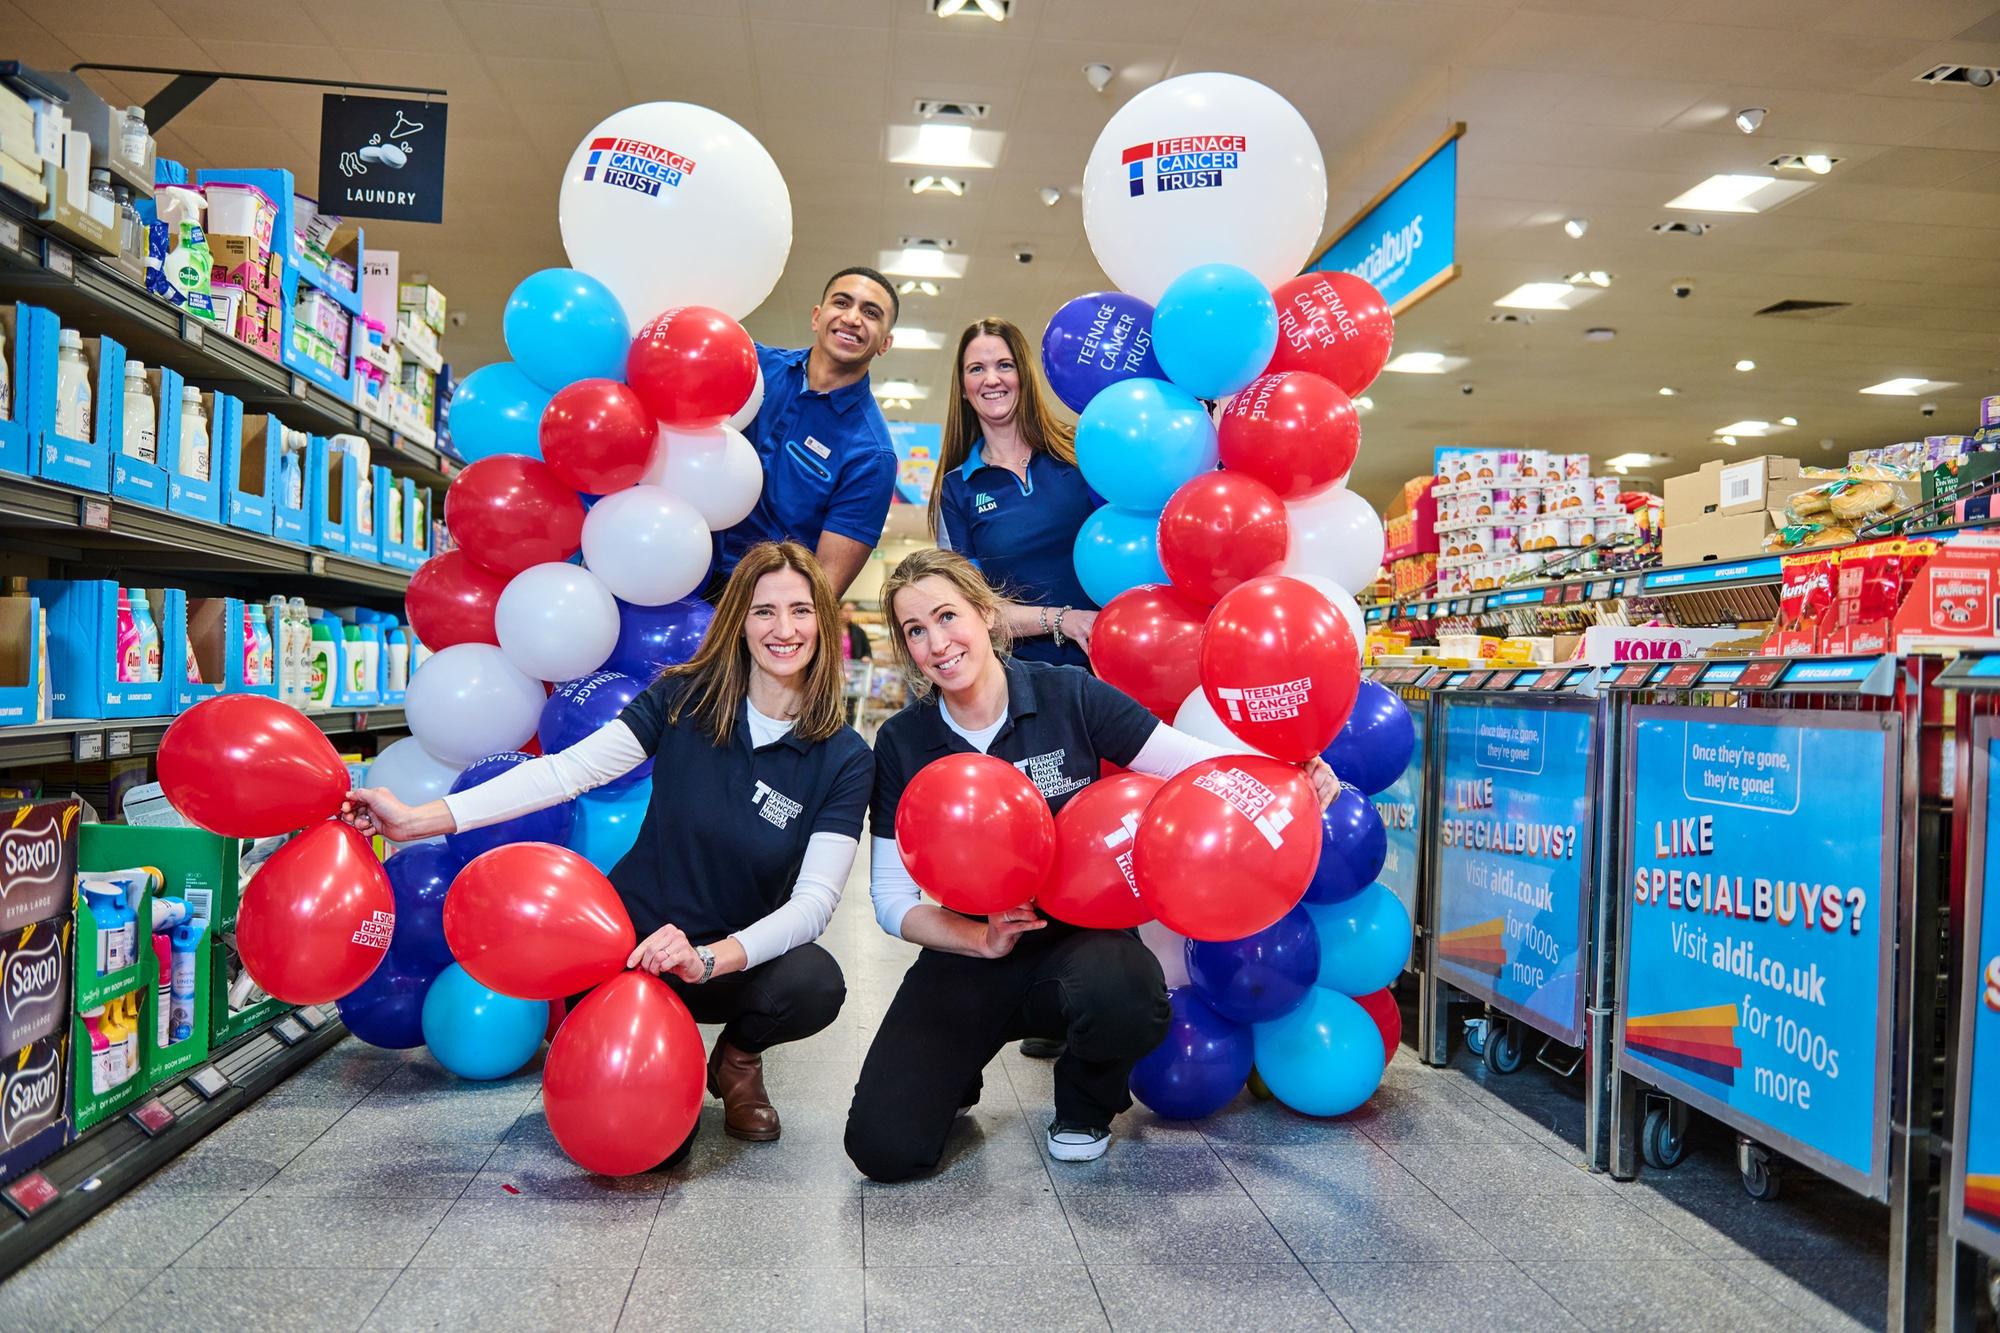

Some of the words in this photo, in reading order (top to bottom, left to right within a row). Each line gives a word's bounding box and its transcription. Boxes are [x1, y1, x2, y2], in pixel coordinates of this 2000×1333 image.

[619, 138, 694, 174] TEENAGE
[1159, 136, 1244, 155] TEENAGE
[611, 153, 680, 186] CANCER
[1158, 152, 1236, 172] CANCER
[608, 169, 659, 194] TRUST
[1159, 171, 1219, 191] TRUST
[347, 188, 416, 206] LAUNDRY
[179, 271, 200, 282] Dettol
[1294, 292, 1336, 349] CANCER
[1313, 280, 1360, 341] TEENAGE
[1077, 303, 1116, 365] TEENAGE
[1100, 313, 1136, 371] CANCER
[1279, 309, 1312, 353] TRUST
[1122, 327, 1152, 373] TRUST
[978, 501, 998, 514] ALDI
[1614, 640, 1682, 661] KOKA
[572, 671, 629, 706] TEENAGE
[1245, 678, 1311, 700] TEENAGE
[1248, 693, 1307, 711] CANCER
[1251, 707, 1296, 722] TRUST
[1481, 723, 1496, 737] Once
[1496, 724, 1519, 742] they're
[1520, 728, 1540, 743] gone,
[1030, 750, 1065, 764] TEENAGE
[1031, 758, 1063, 771] CANCER
[1487, 743, 1510, 761] they're
[1510, 748, 1530, 763] gone!
[1692, 743, 1716, 762] Once
[1718, 745, 1755, 767] they're
[1757, 752, 1790, 773] gone,
[1032, 767, 1058, 777] TRUST
[1034, 773, 1062, 784] YOUTH
[1043, 777, 1091, 797] O-ORDINATOR
[1229, 769, 1272, 800] TRUST
[1703, 770, 1739, 793] they're
[1741, 777, 1775, 796] gone!
[767, 797, 797, 818] CANCER
[771, 791, 803, 813] TEENAGE
[1195, 777, 1258, 819] TEENAGE
[1456, 777, 1493, 812] LIKE
[760, 809, 786, 829] NURSE
[764, 803, 788, 820] TRUST
[1443, 818, 1577, 858] SPECIALBUYS?
[1655, 814, 1714, 859] LIKE
[5, 839, 56, 875] Saxon
[1466, 859, 1488, 890] Visit
[1491, 865, 1554, 913] aldi.co.uk
[1634, 866, 1867, 935] SPECIALBUYS?
[6, 902, 29, 918] EXTRA
[30, 896, 52, 912] LARGE
[1506, 908, 1524, 941] for
[1525, 922, 1560, 966] 1000s
[12, 958, 57, 998] Saxon
[1512, 960, 1545, 990] more
[1671, 921, 1708, 965] Visit
[1711, 935, 1826, 1007] aldi.co.uk
[1742, 994, 1772, 1039] for
[1775, 1014, 1840, 1080] 1000s
[10, 1074, 55, 1119] Saxon
[1755, 1065, 1811, 1110] more
